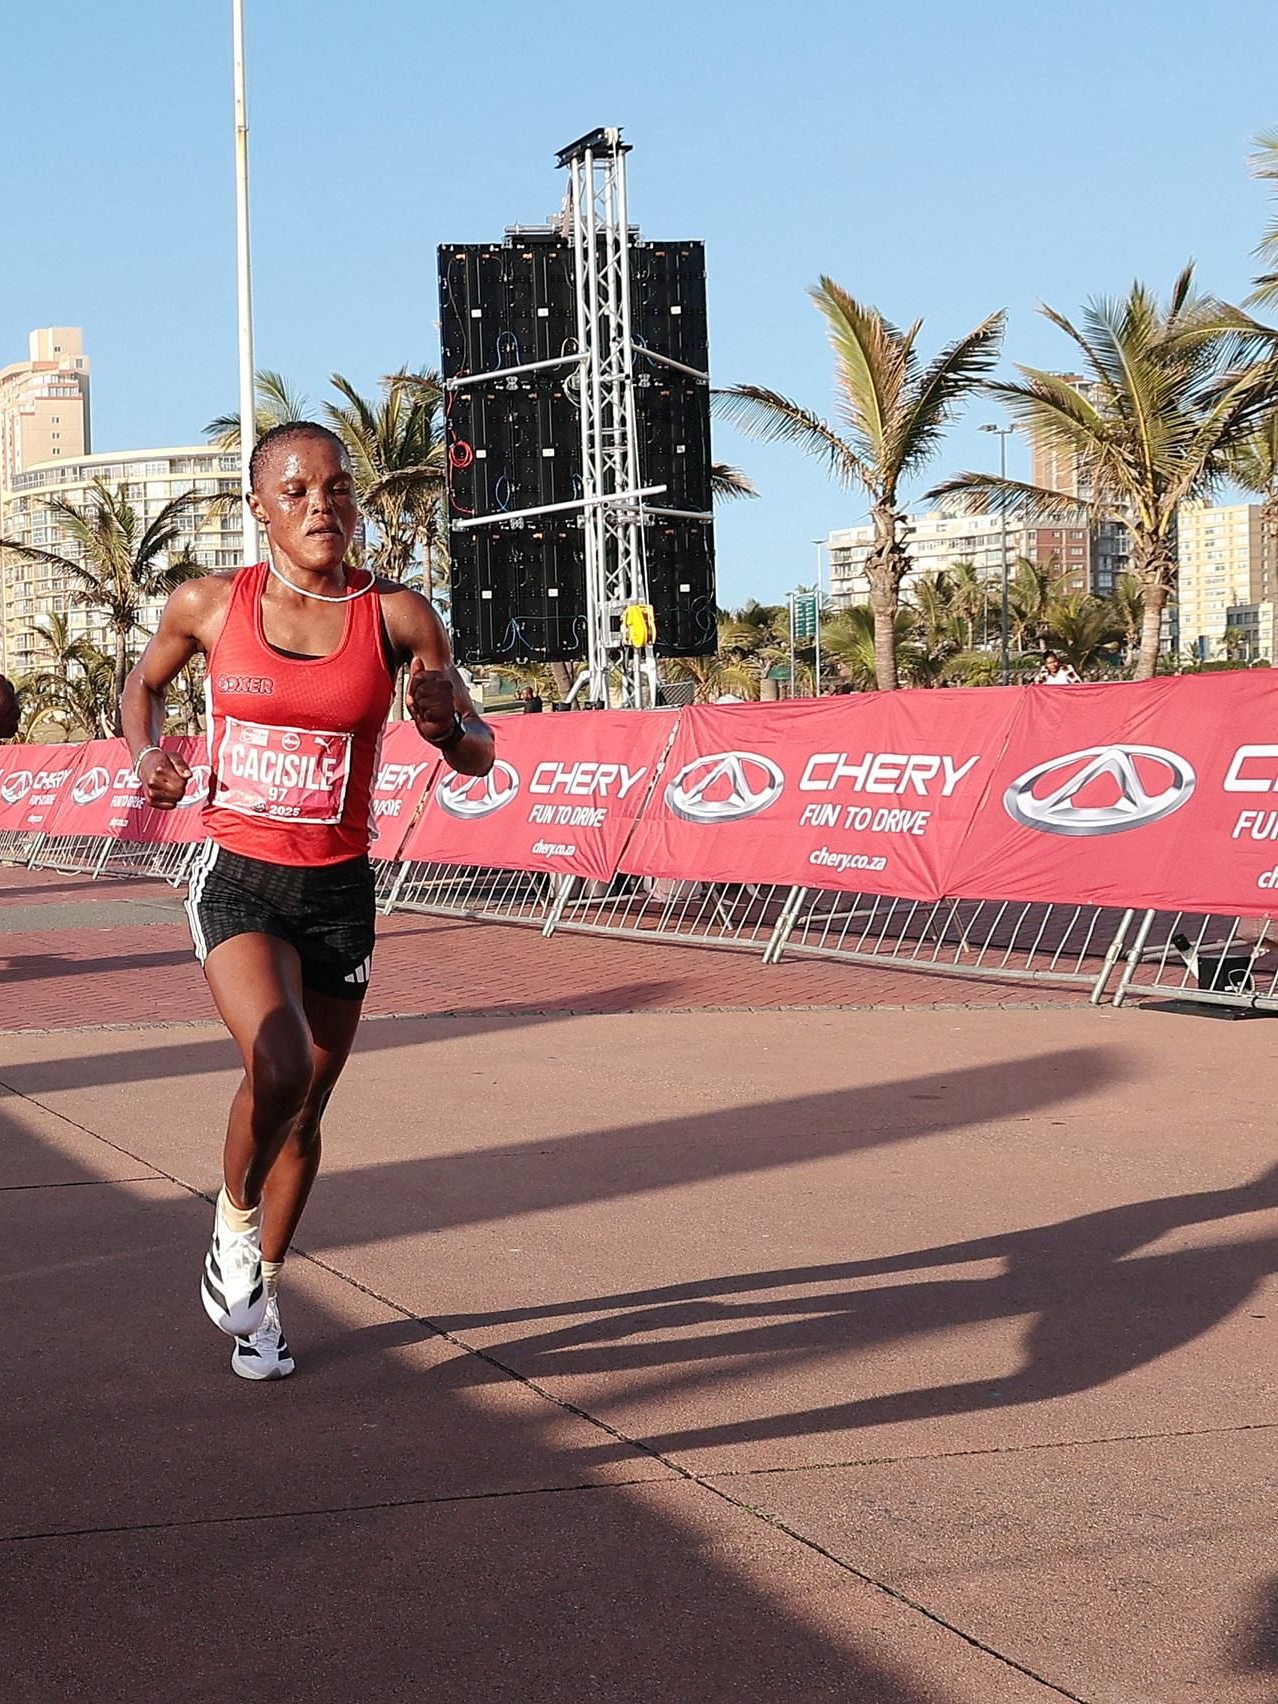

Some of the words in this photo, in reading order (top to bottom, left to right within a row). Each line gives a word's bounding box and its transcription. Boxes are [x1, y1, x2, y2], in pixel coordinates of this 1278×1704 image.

[231, 743, 337, 791] CACISILE
[529, 761, 648, 799] CHERY
[798, 752, 981, 797] CHERY
[268, 786, 289, 802] 97
[268, 804, 301, 817] 2025
[528, 804, 557, 825] FUN
[554, 805, 573, 826] TO
[569, 806, 608, 828] DRIVE
[799, 803, 843, 829] FUN
[843, 805, 872, 832] TO
[871, 808, 931, 836] DRIVE
[808, 846, 888, 873] chery.co.za
